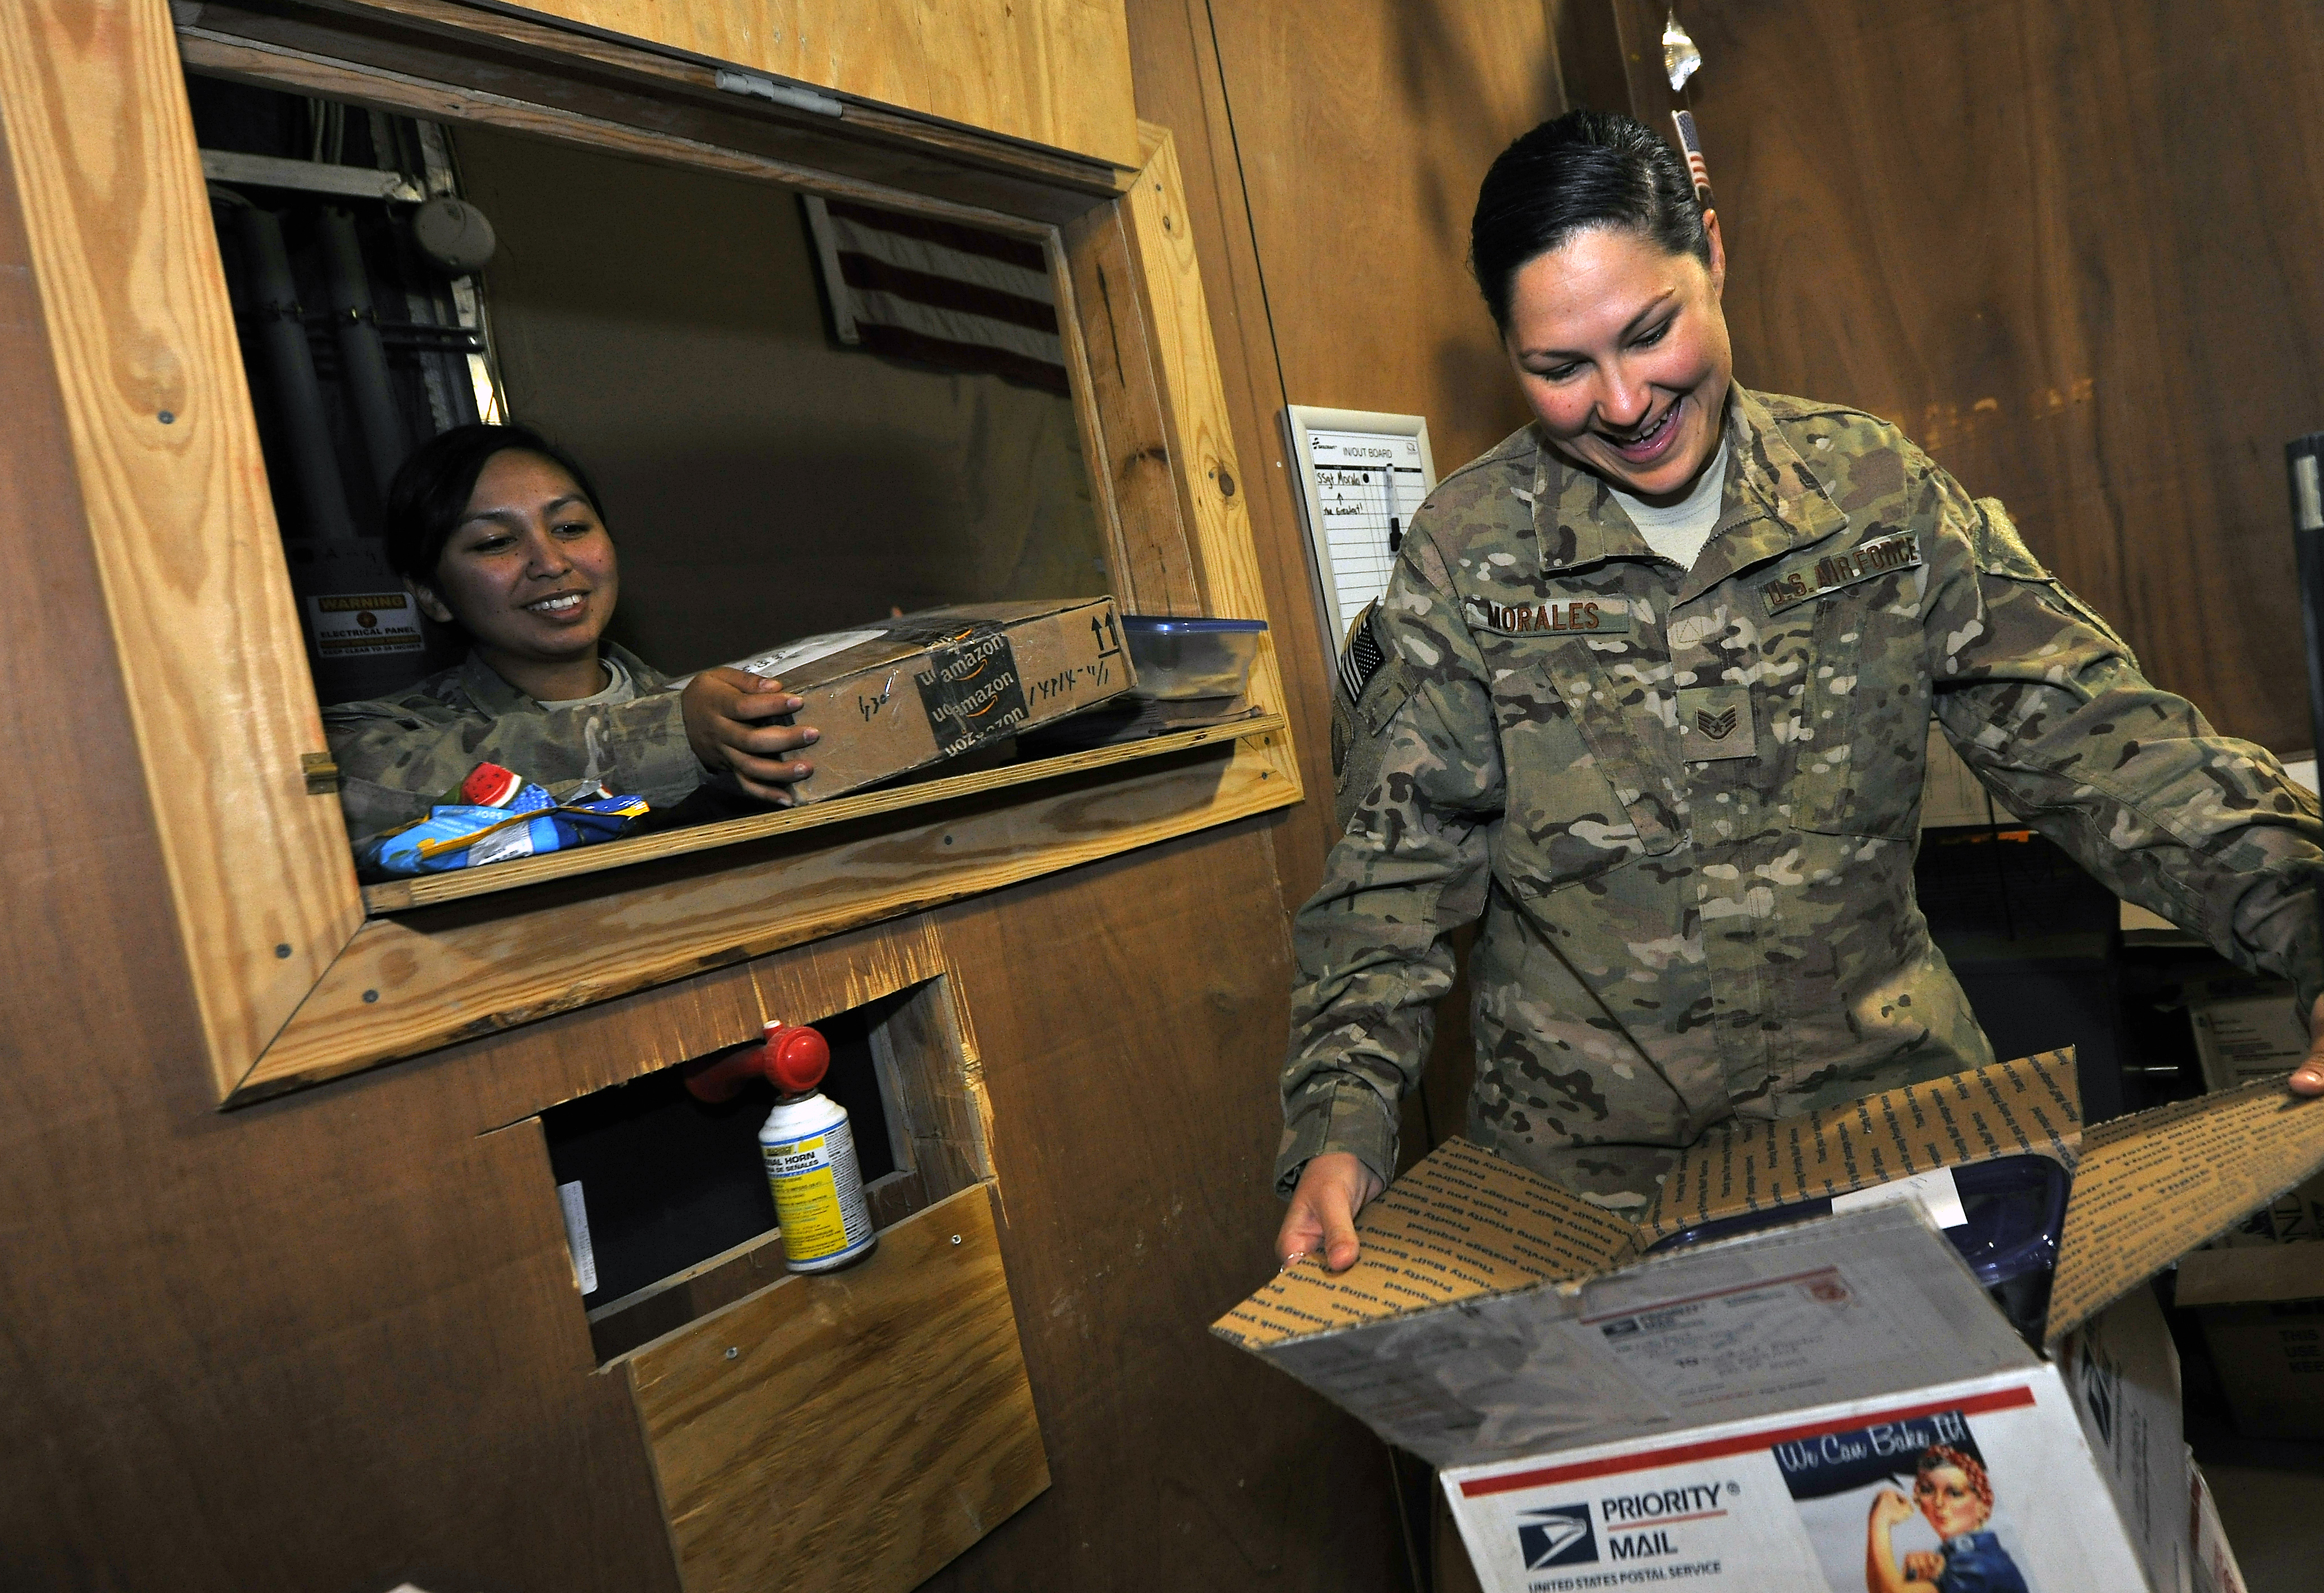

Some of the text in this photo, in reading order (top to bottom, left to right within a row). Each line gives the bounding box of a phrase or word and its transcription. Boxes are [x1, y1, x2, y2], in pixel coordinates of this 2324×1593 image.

[1368, 448, 1392, 458] BOARD
[1765, 571, 1815, 606] U.S.
[1814, 556, 1855, 589] AIR
[320, 595, 405, 610] WARNING
[1487, 601, 1599, 633] MORALES
[320, 626, 416, 637] ELECTRICAL PANEL
[940, 633, 1005, 684] amazon
[951, 670, 1014, 720] amazon
[784, 1151, 816, 1165] HORN
[1778, 1411, 1967, 1474] We Can Bake It!
[1609, 1529, 1679, 1560] MAIL
[1528, 1559, 1722, 1593] UNITED STATES POSTAL SERVICE
